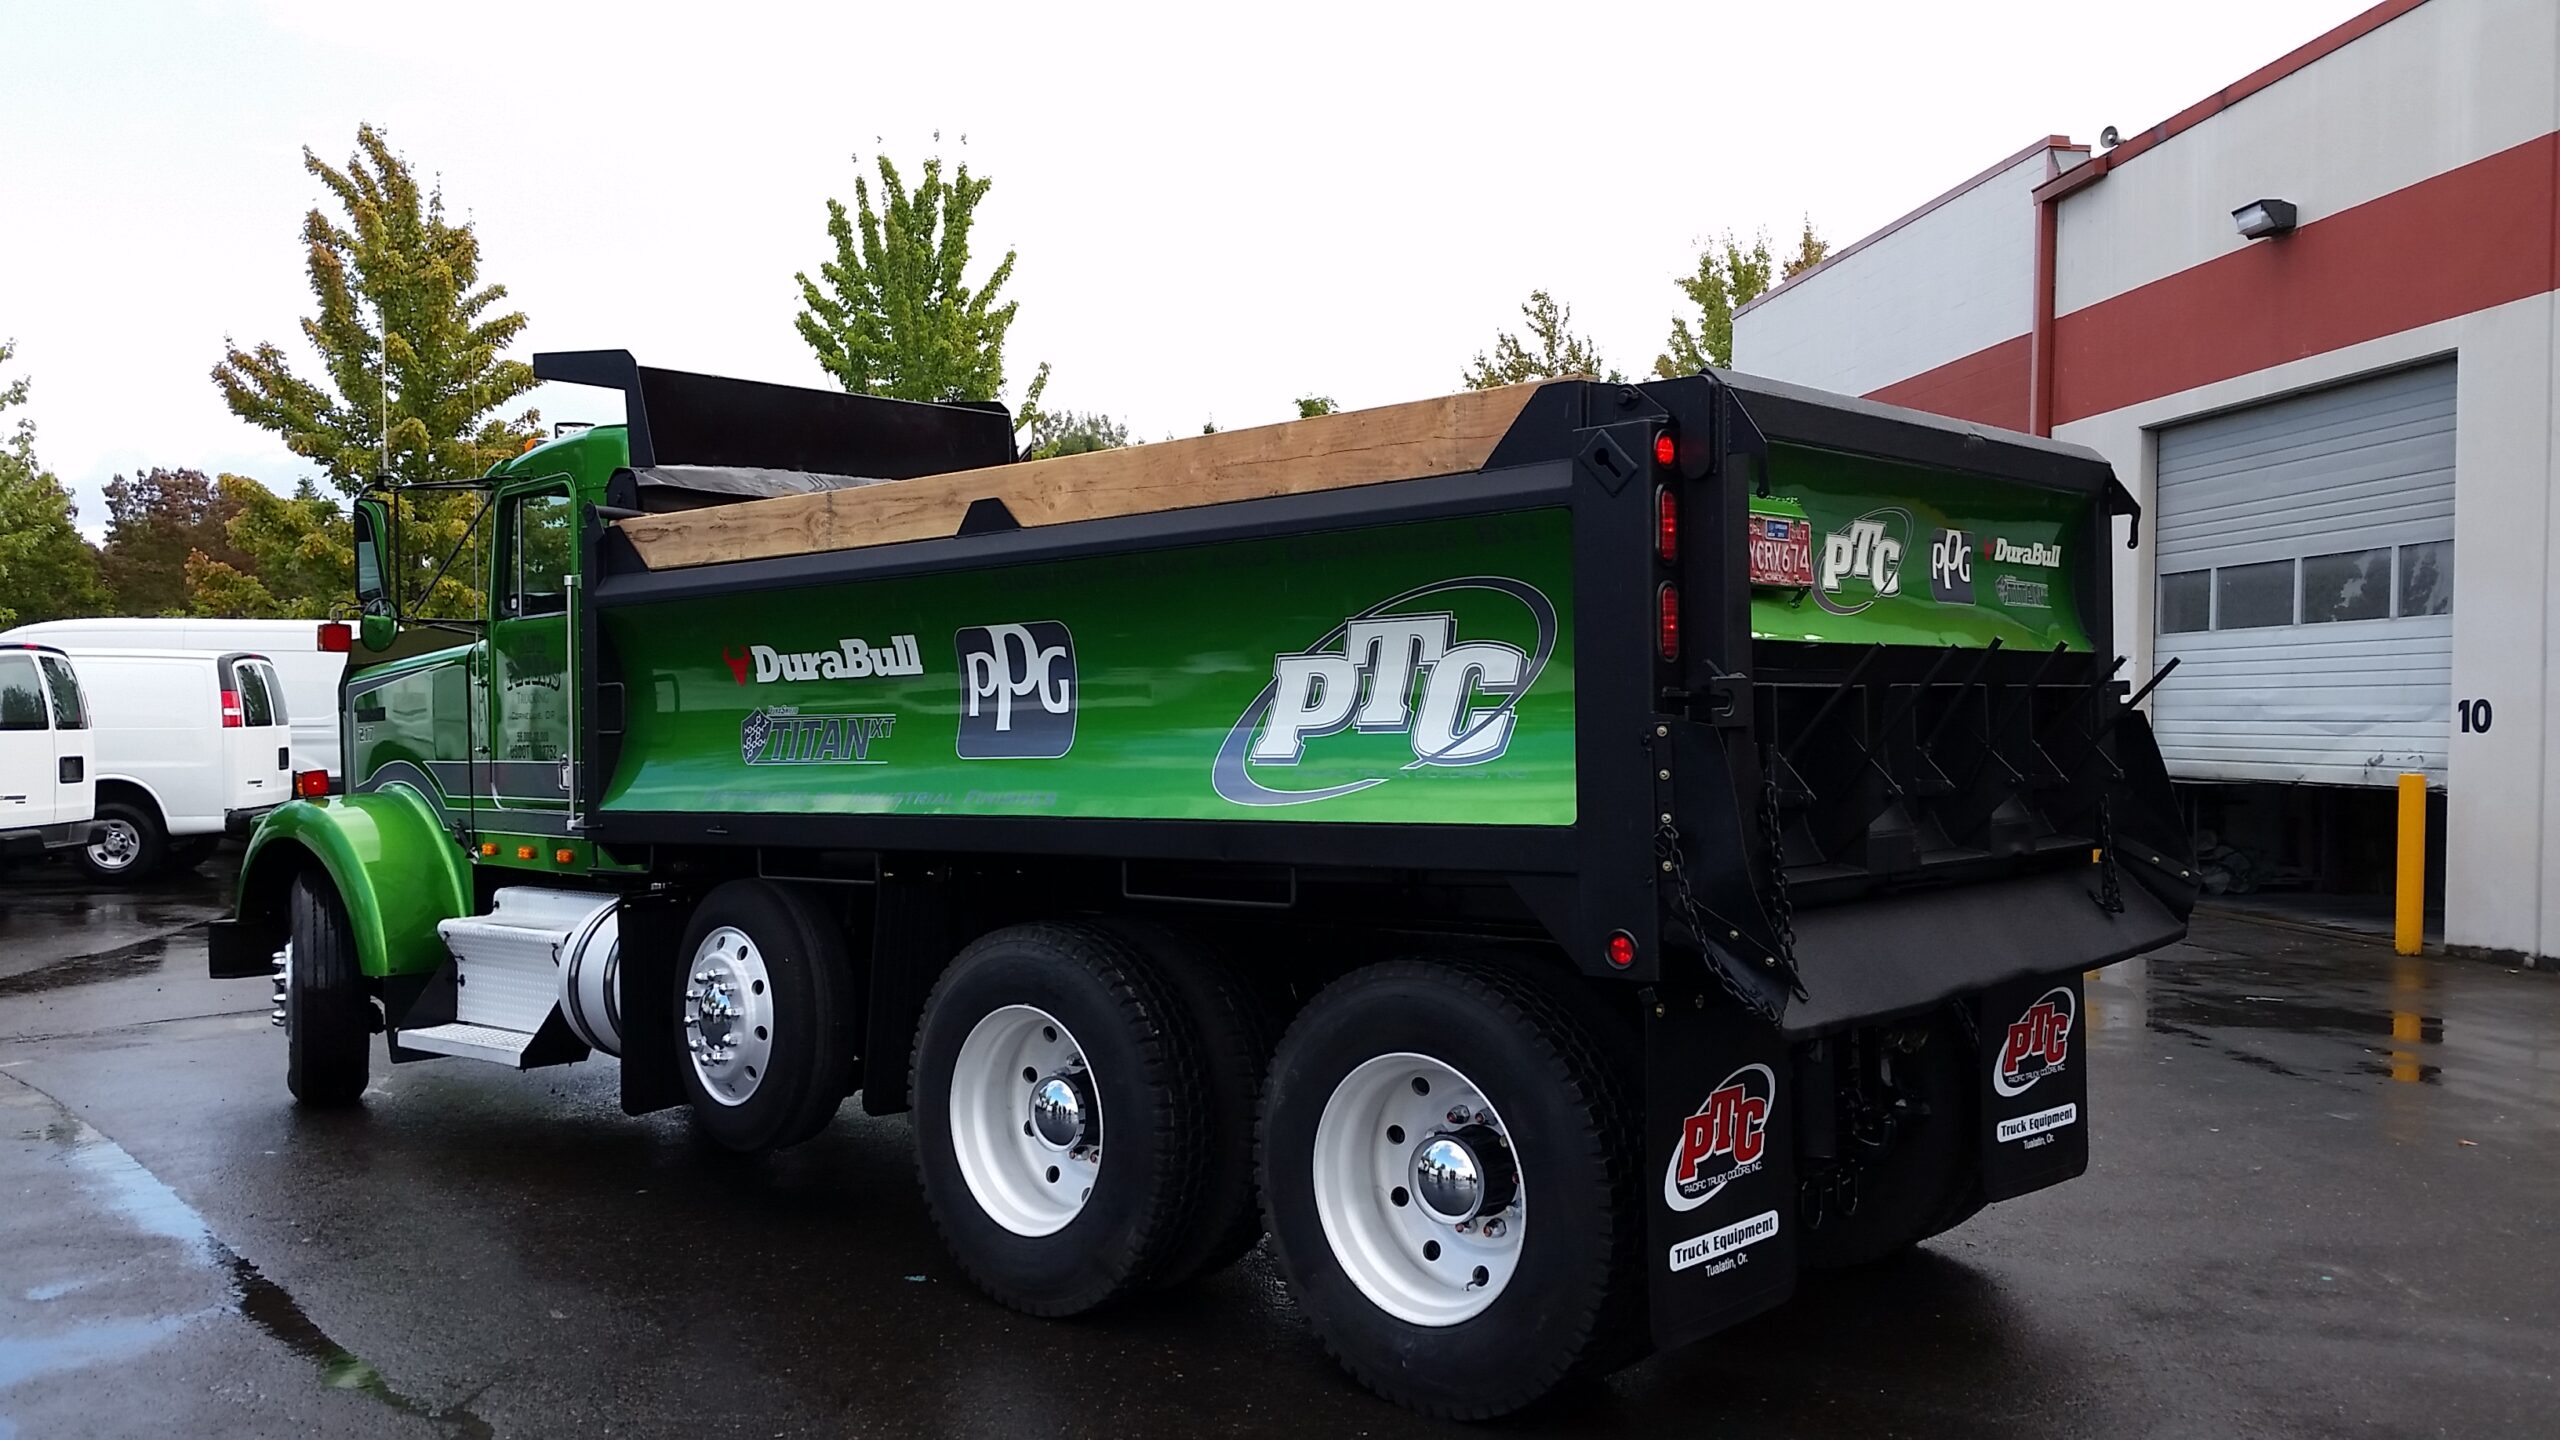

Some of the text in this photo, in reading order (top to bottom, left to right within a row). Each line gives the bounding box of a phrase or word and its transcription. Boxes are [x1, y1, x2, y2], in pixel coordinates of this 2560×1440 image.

[1749, 540, 1810, 573] YCRX674
[1822, 520, 1901, 598] PTC
[1932, 529, 1972, 590] PPG
[1994, 537, 2061, 568] DuraBull
[750, 634, 924, 683] DuraBull
[965, 623, 1070, 731] PPG
[1250, 611, 1531, 767] PTC
[771, 717, 897, 761] TITAN XT
[2457, 698, 2493, 734] 10
[2003, 1002, 2069, 1076] PTC
[1678, 1084, 1767, 1185] PTC
[2001, 1108, 2073, 1137] Truck Equipment
[1675, 1217, 1773, 1264] Truck Equipment
[1705, 1252, 1748, 1277] Tualatin, Or.
